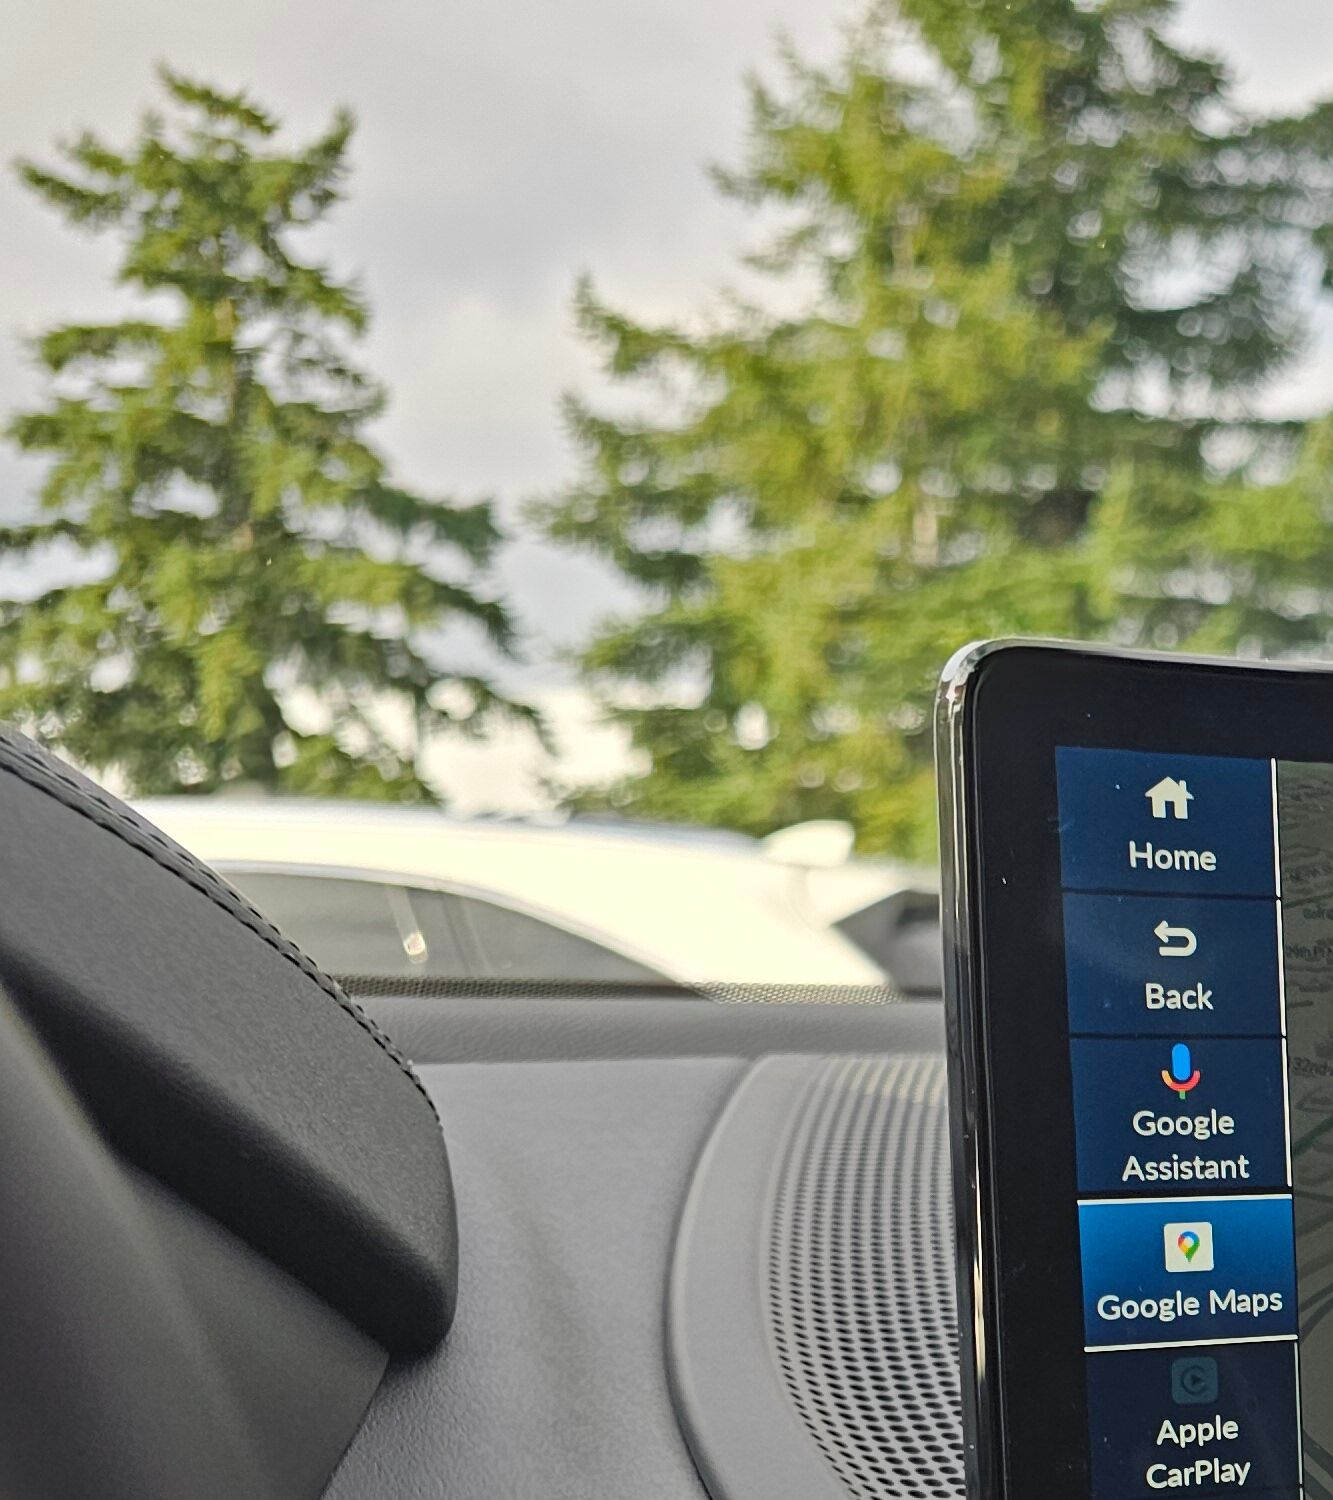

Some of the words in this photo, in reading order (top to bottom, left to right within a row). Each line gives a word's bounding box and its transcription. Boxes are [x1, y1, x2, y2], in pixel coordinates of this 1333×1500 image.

[1128, 840, 1218, 872] Home
[1144, 982, 1214, 1011] Back
[1291, 1056, 1328, 1077] 32nd
[1132, 1109, 1235, 1141] Google
[1121, 1154, 1250, 1182] Assistant
[1096, 1290, 1200, 1322] Google
[1209, 1288, 1284, 1320] Maps
[1156, 1414, 1240, 1449] Apple
[1145, 1457, 1252, 1490] CarPlay
